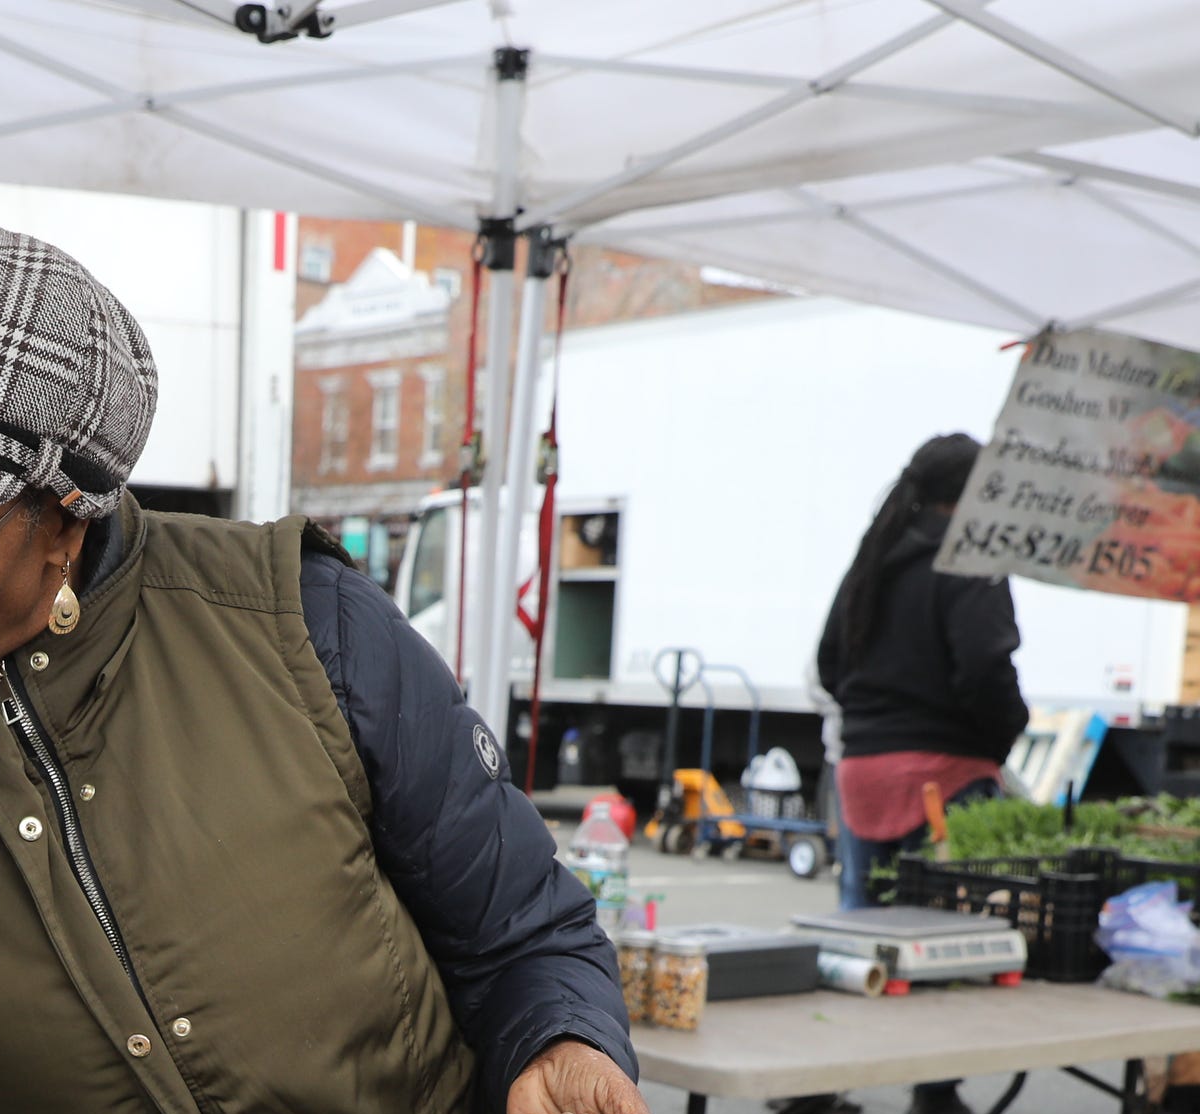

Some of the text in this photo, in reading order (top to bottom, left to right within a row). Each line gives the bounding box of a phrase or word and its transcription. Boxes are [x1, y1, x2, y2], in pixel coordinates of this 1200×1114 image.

[1016, 379, 1103, 420] Goshen
[979, 468, 1007, 504] &
[1010, 480, 1075, 517] Fruit
